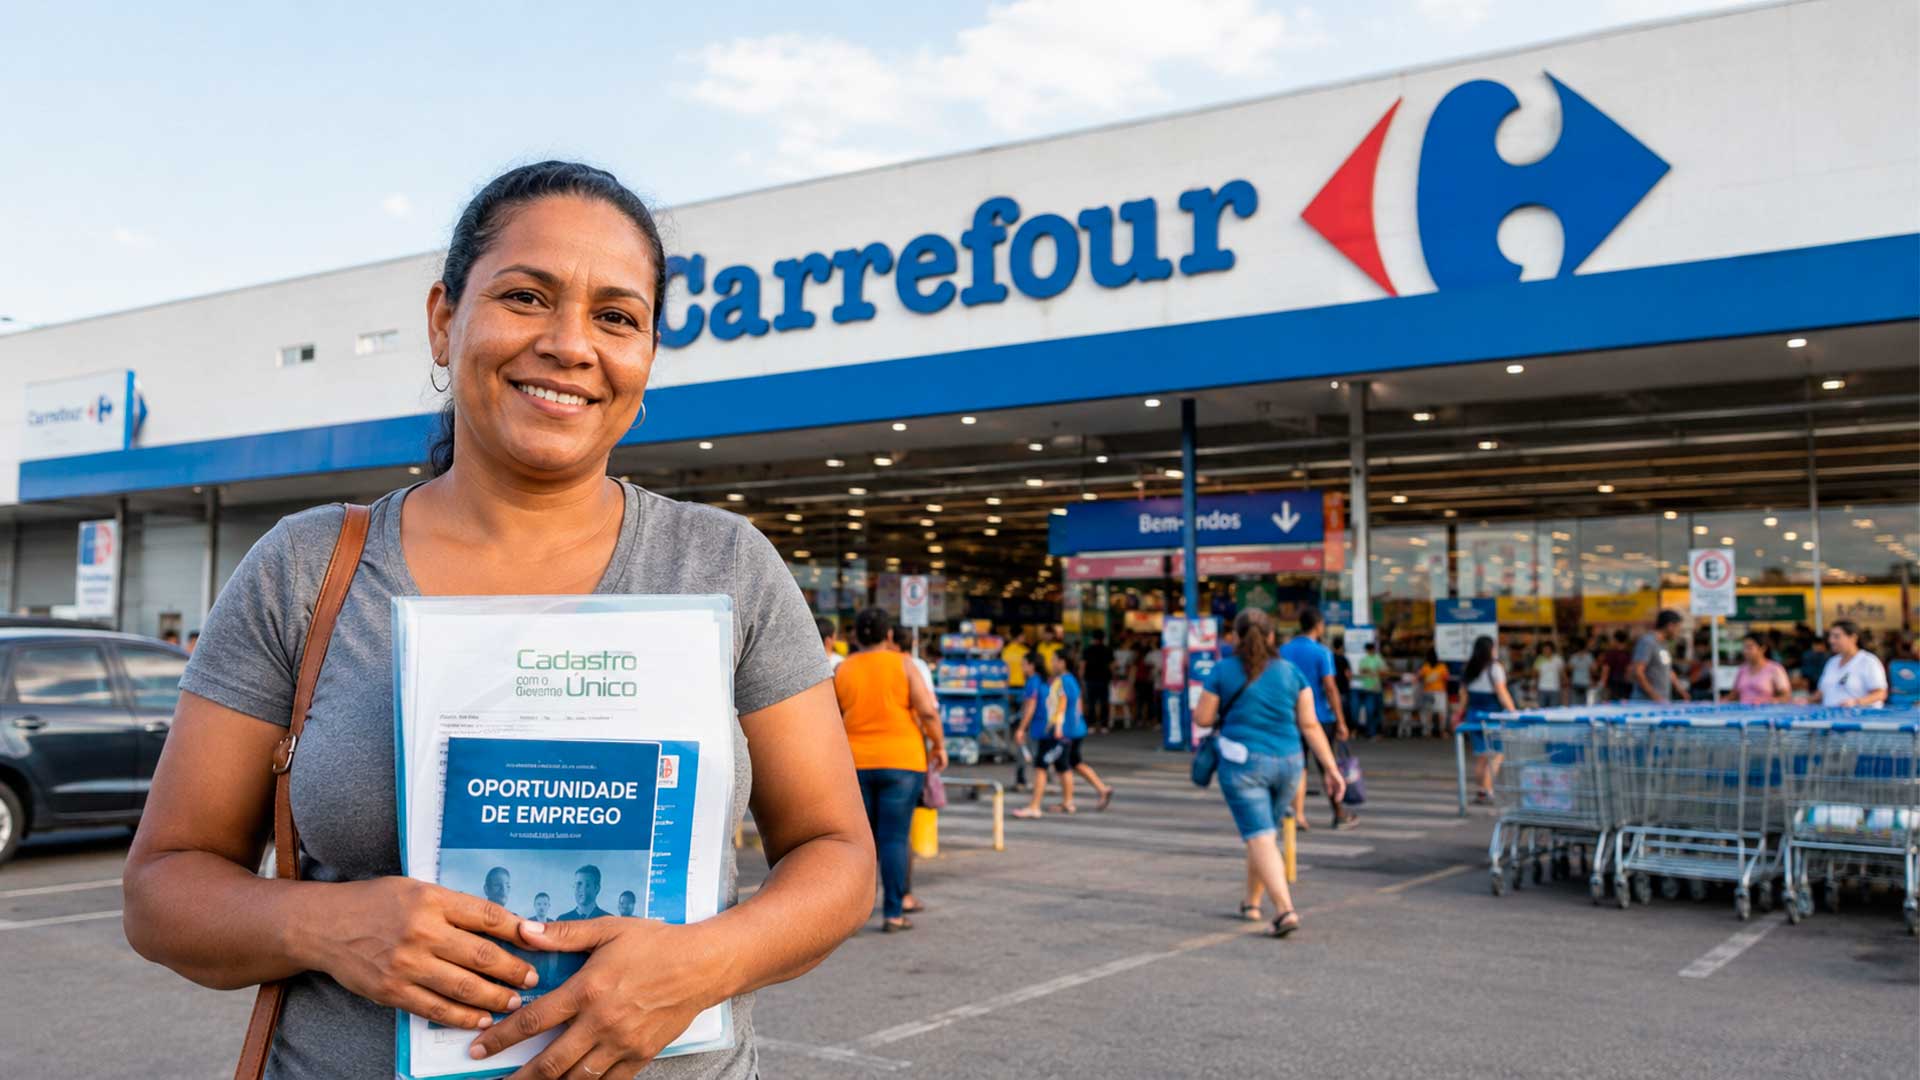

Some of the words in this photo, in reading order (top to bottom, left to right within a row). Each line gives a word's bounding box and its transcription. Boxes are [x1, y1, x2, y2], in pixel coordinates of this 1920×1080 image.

[658, 179, 1258, 348] Carrefour
[1139, 510, 1241, 533] Bem-ndos
[1704, 559, 1719, 580] E
[517, 650, 637, 670] Cadastro
[516, 676, 539, 686] com
[541, 676, 549, 686] o
[566, 672, 637, 696] Único
[467, 778, 638, 799] OPORTUNIDADE
[481, 805, 510, 823] DE
[516, 806, 621, 825] EMPREGO
